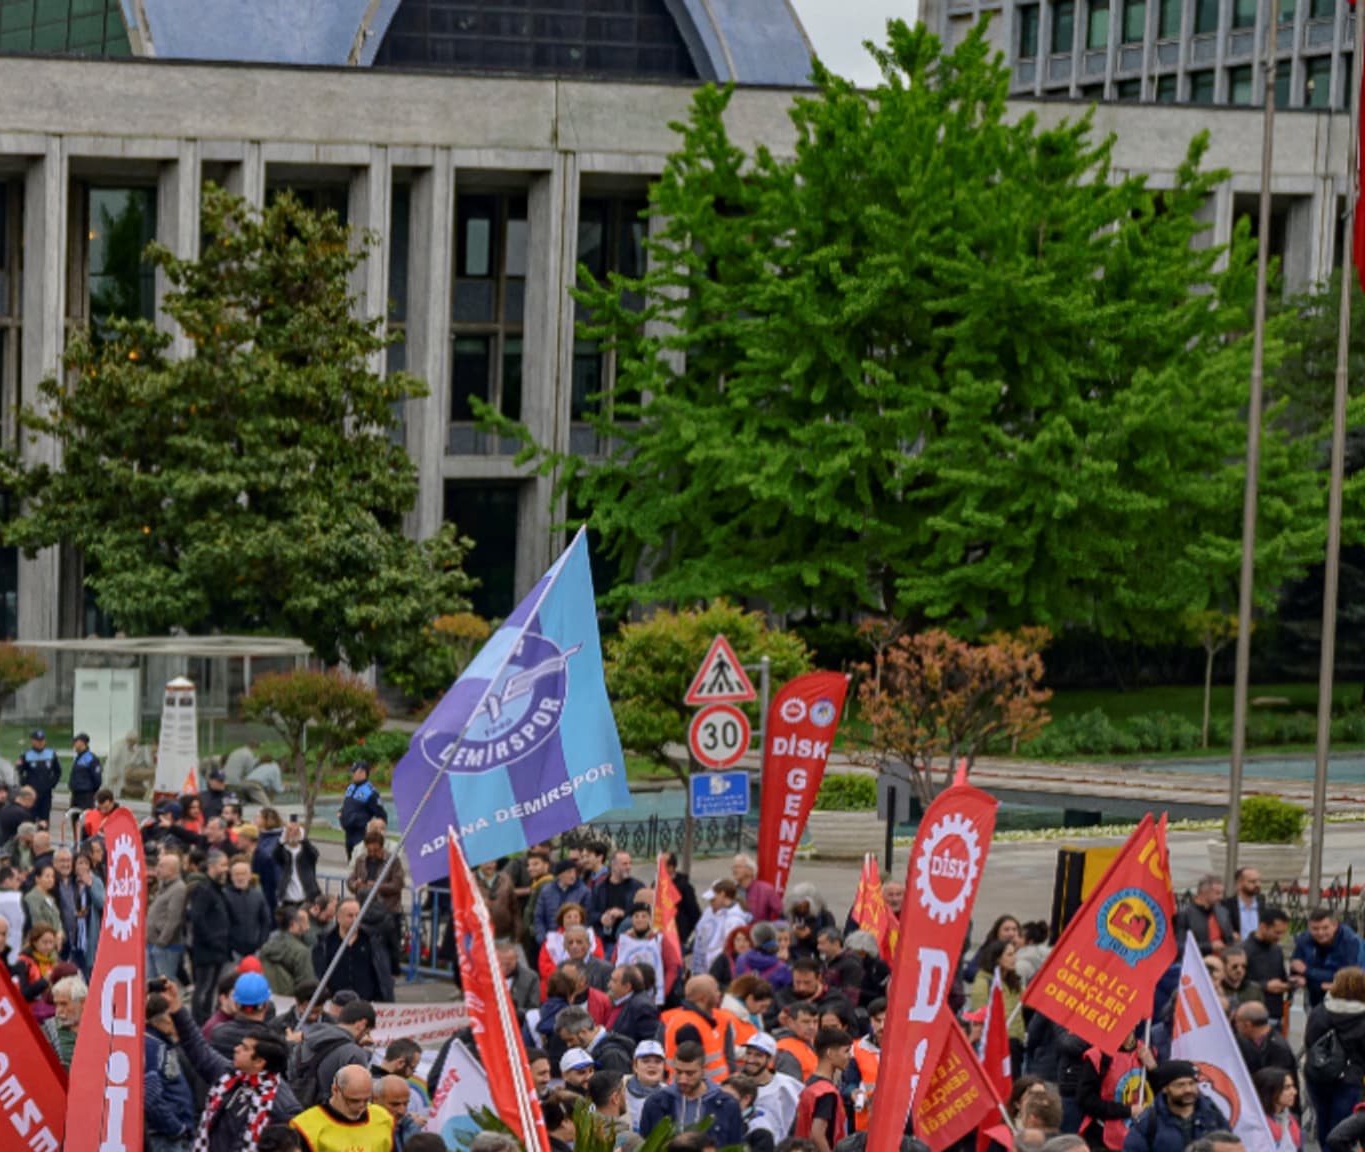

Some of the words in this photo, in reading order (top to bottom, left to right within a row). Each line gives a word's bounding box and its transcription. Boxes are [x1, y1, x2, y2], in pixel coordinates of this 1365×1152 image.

[438, 696, 561, 768] DEMİRSPOR
[703, 719, 739, 751] 30
[772, 734, 830, 760] DİSK
[420, 816, 489, 858] ADANA
[494, 761, 616, 824] DEMİRSPOR
[772, 767, 809, 897] GENEL
[930, 848, 967, 881] DİSK
[1055, 968, 1126, 1017] GENÇLER
[1065, 951, 1138, 1002] İLERİCİ
[1044, 983, 1118, 1033] DERNEĞİ
